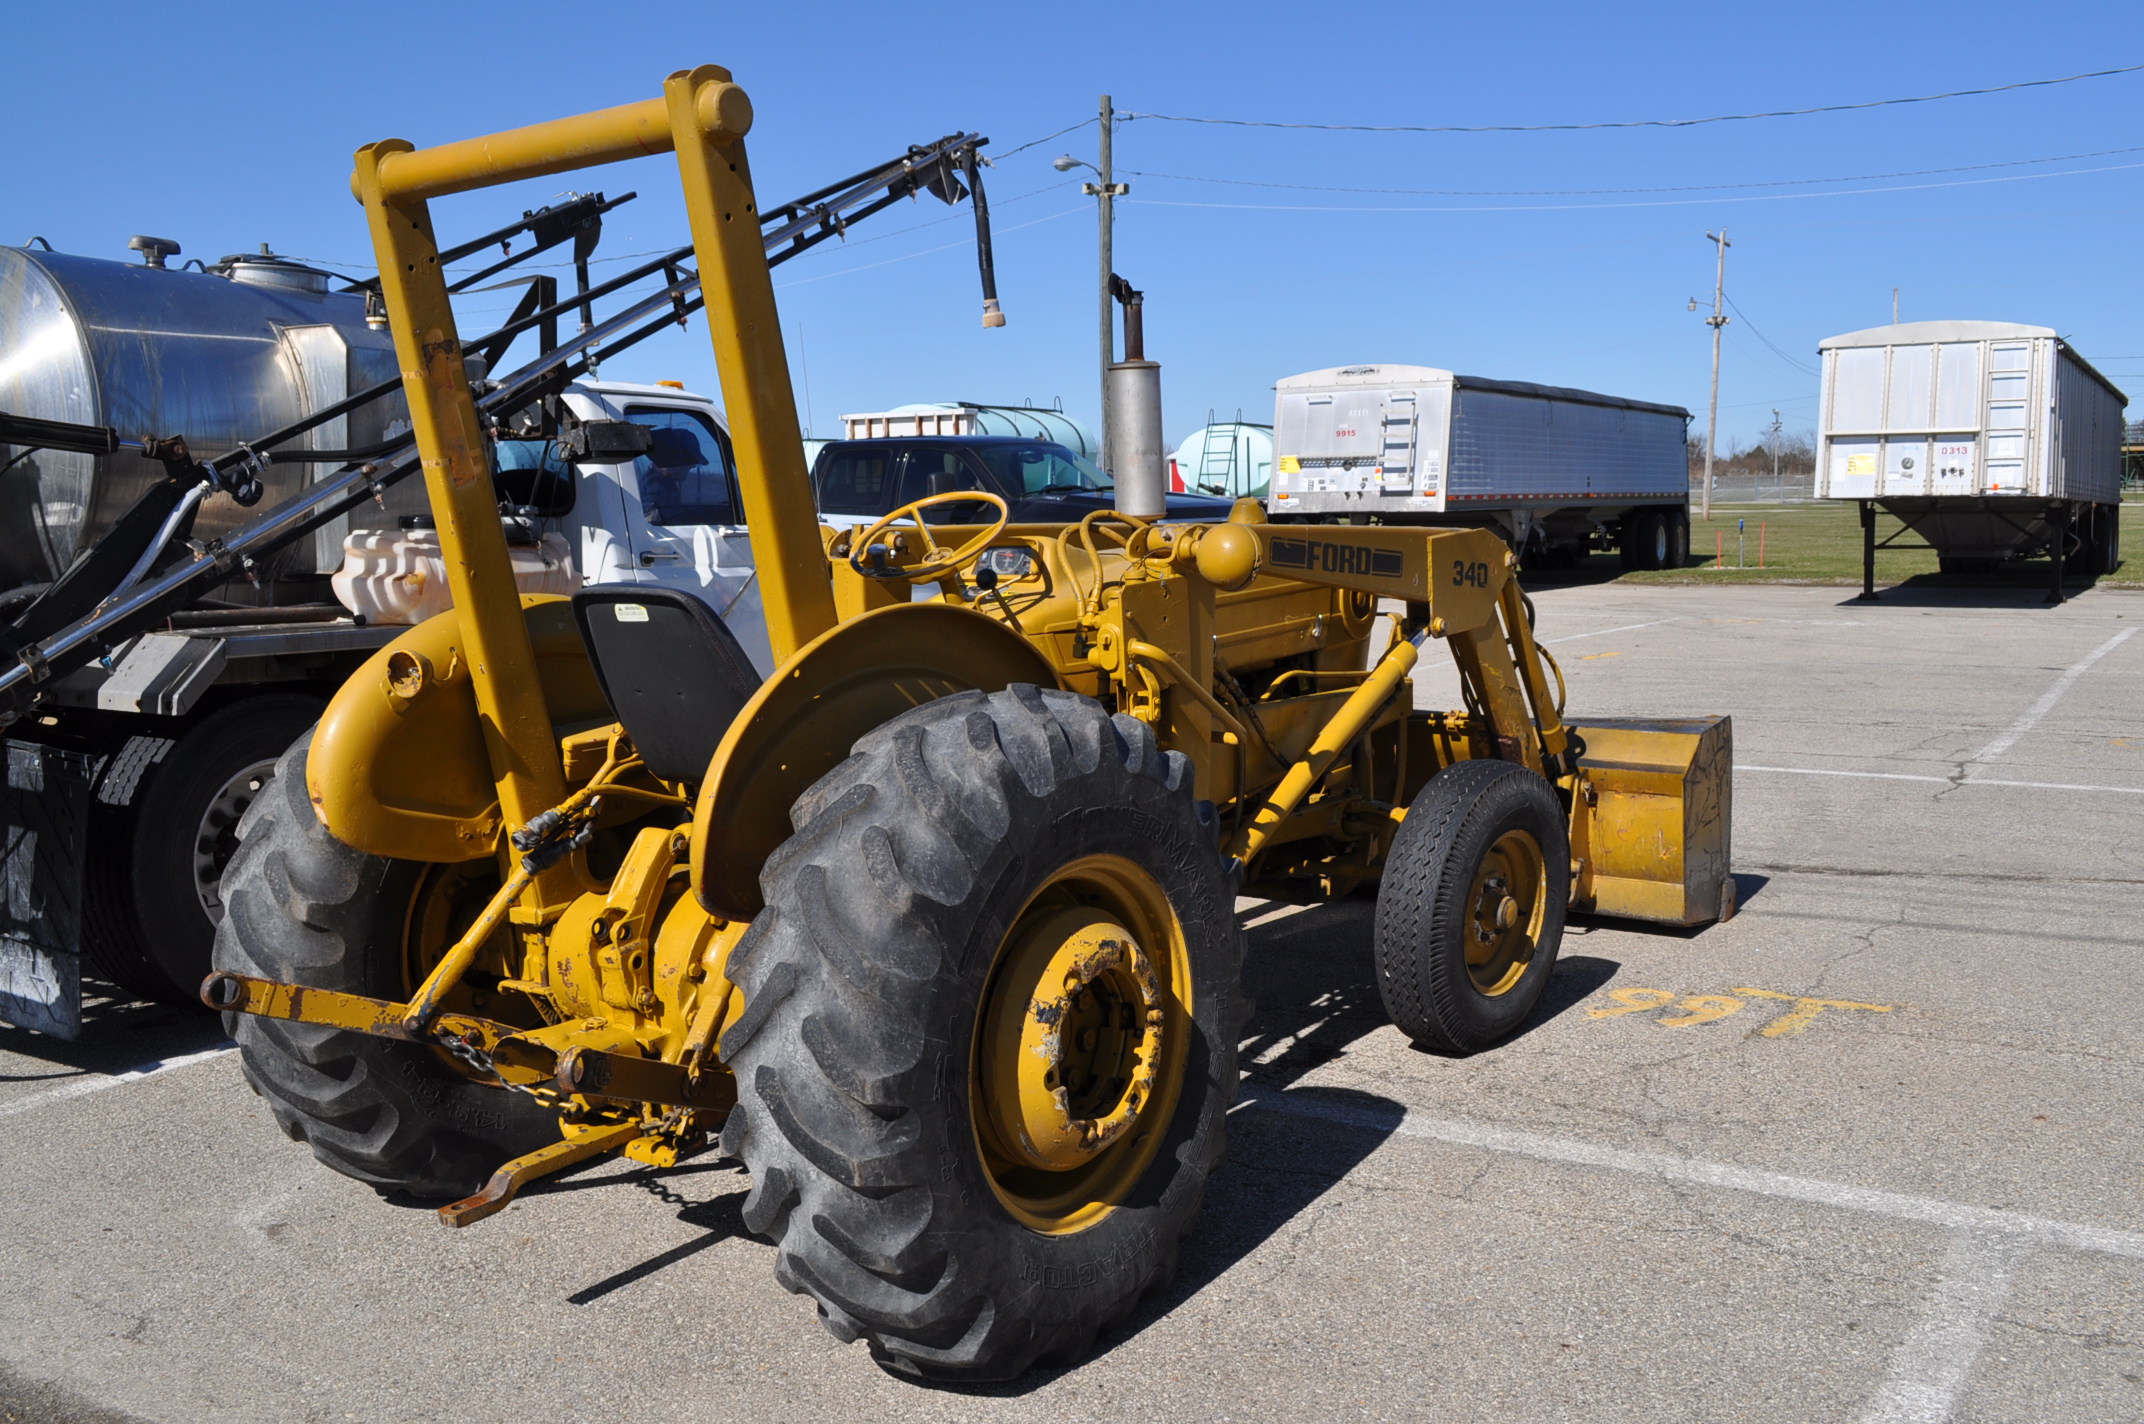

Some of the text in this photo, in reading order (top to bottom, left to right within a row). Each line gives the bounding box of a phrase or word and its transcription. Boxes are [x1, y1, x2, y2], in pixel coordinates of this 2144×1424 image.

[1335, 429, 1356, 438] 9915
[1941, 446, 1968, 455] 0313
[1306, 541, 1372, 576] FORD
[1452, 560, 1489, 588] 340
